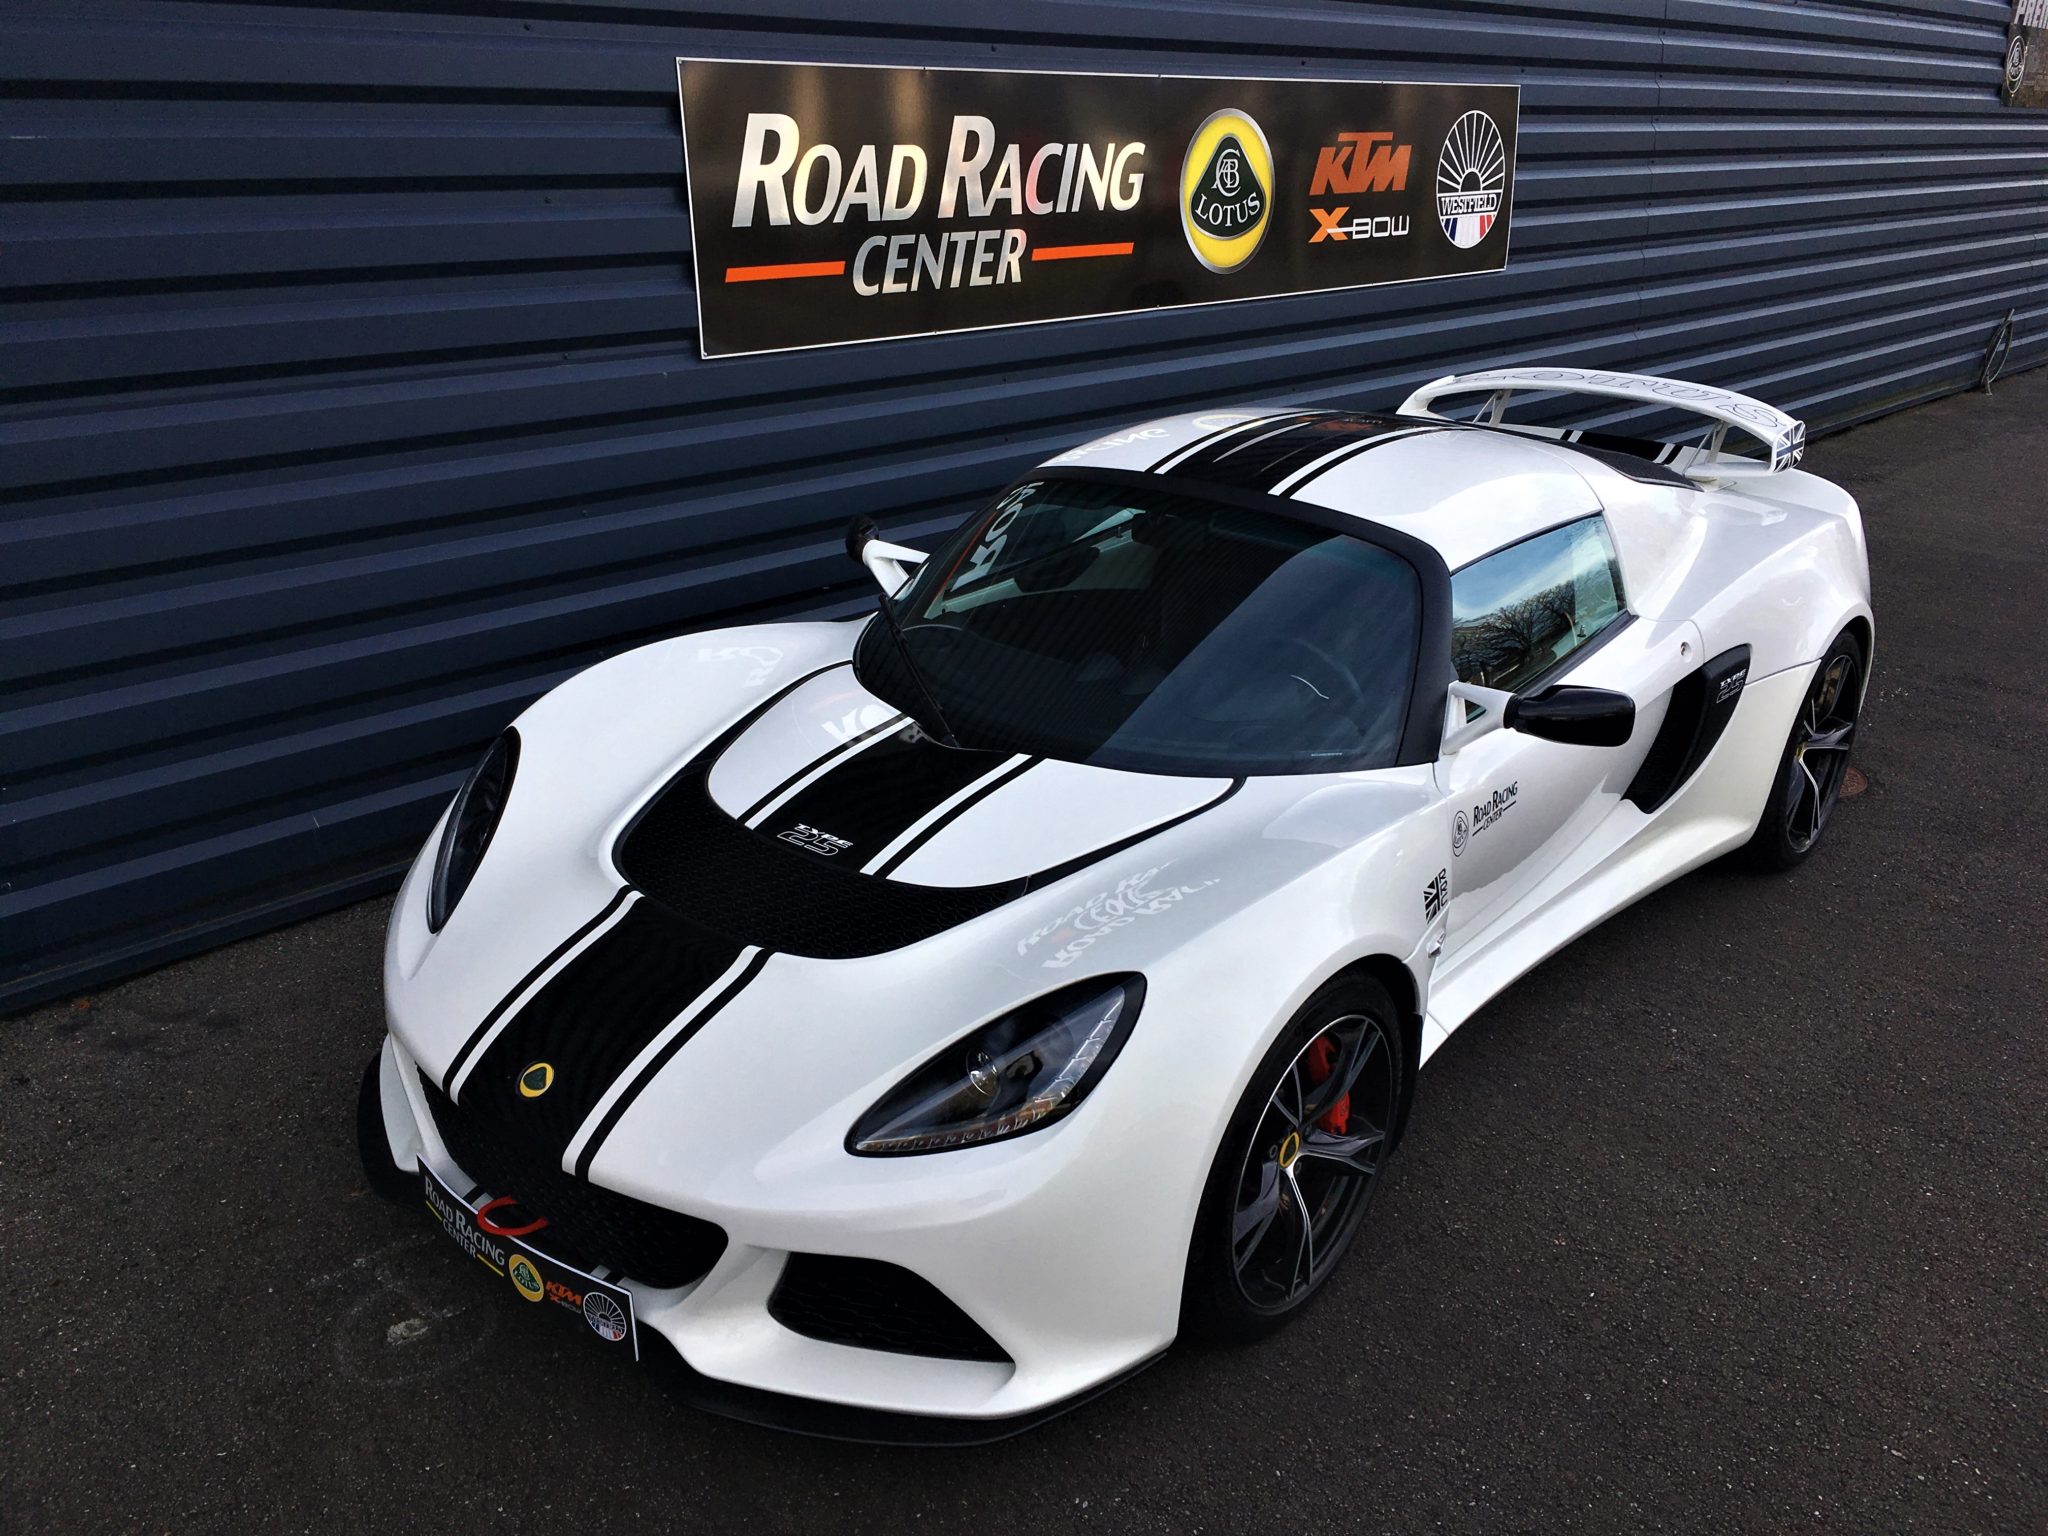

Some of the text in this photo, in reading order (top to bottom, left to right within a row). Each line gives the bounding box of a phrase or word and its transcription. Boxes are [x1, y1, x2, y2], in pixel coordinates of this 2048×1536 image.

[731, 112, 1147, 228] ROAD RACING
[1309, 131, 1412, 196] KTM
[1195, 191, 1261, 227] LOTUS
[1440, 193, 1498, 216] WESTFIELD
[851, 227, 1028, 297] CENTER
[1472, 780, 1518, 827] ROAD RACING
[776, 828, 848, 856] 25
[425, 1175, 505, 1266] ROAD RACING
[442, 1218, 477, 1259] CENTER
[545, 1280, 582, 1306] KTM
